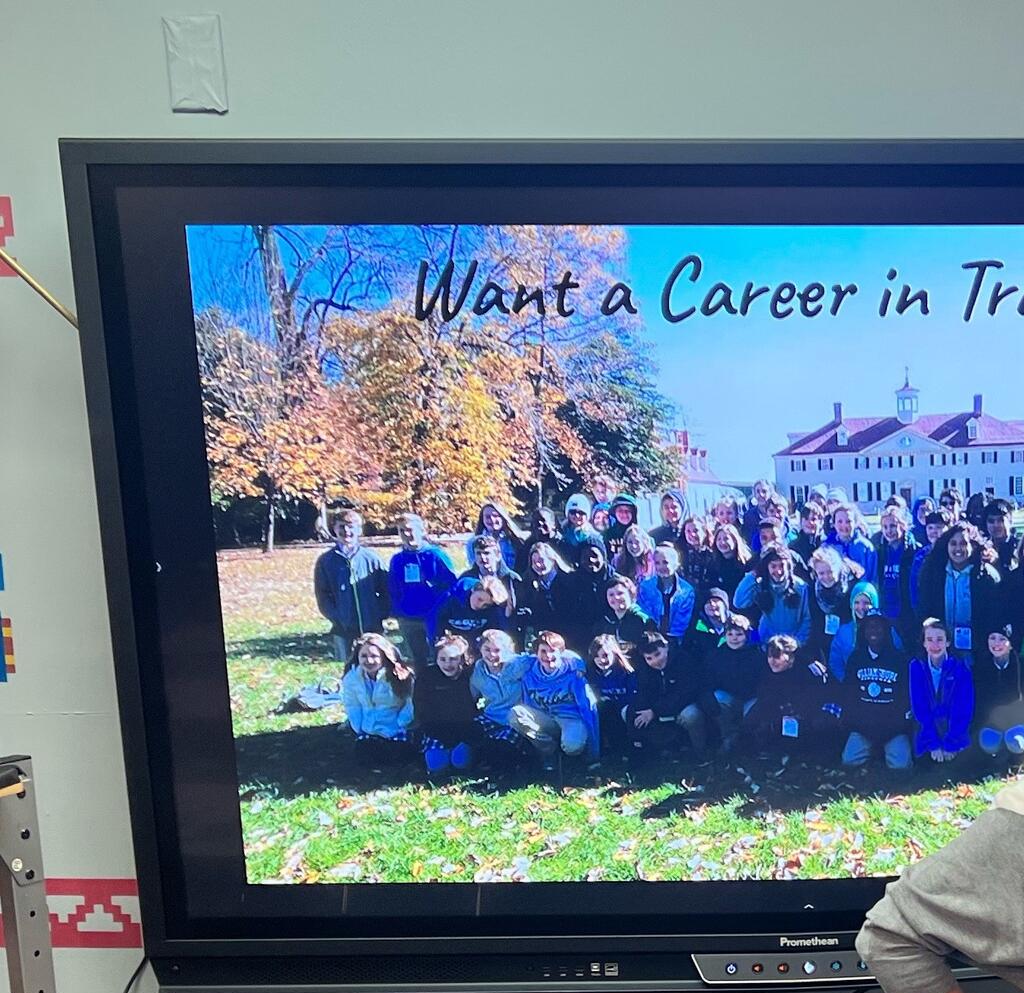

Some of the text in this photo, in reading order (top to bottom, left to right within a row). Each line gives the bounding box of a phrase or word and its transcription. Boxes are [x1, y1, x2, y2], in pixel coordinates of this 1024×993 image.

[415, 259, 579, 322] Want
[601, 282, 638, 316] a
[661, 254, 859, 323] Career
[879, 267, 930, 317] in
[779, 935, 840, 948] Promethean
